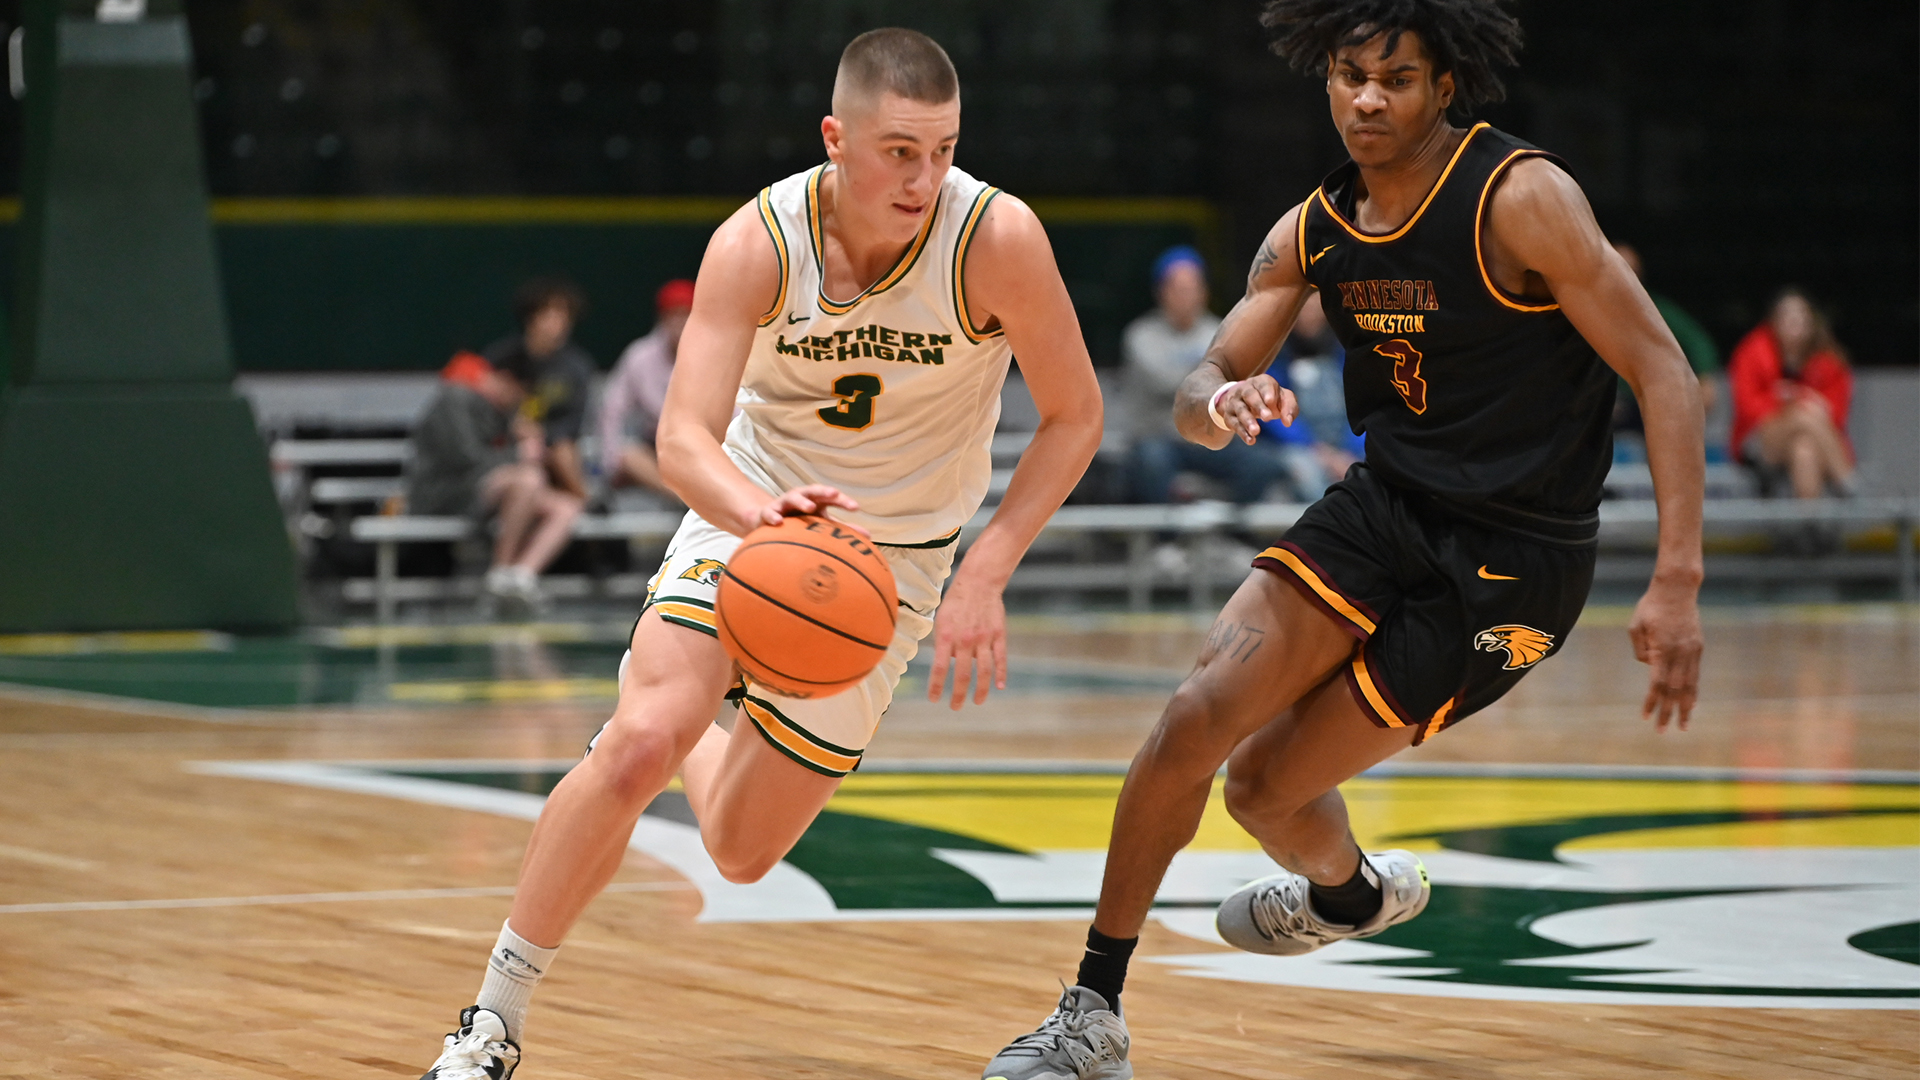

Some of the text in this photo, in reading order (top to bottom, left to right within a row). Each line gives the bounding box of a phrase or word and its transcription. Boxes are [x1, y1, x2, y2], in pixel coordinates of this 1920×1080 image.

[775, 341, 945, 365] MICHIGAN
[777, 324, 953, 349] RTHERN
[1373, 338, 1427, 415] 3
[815, 372, 885, 432] 3
[805, 521, 873, 556] EVO
